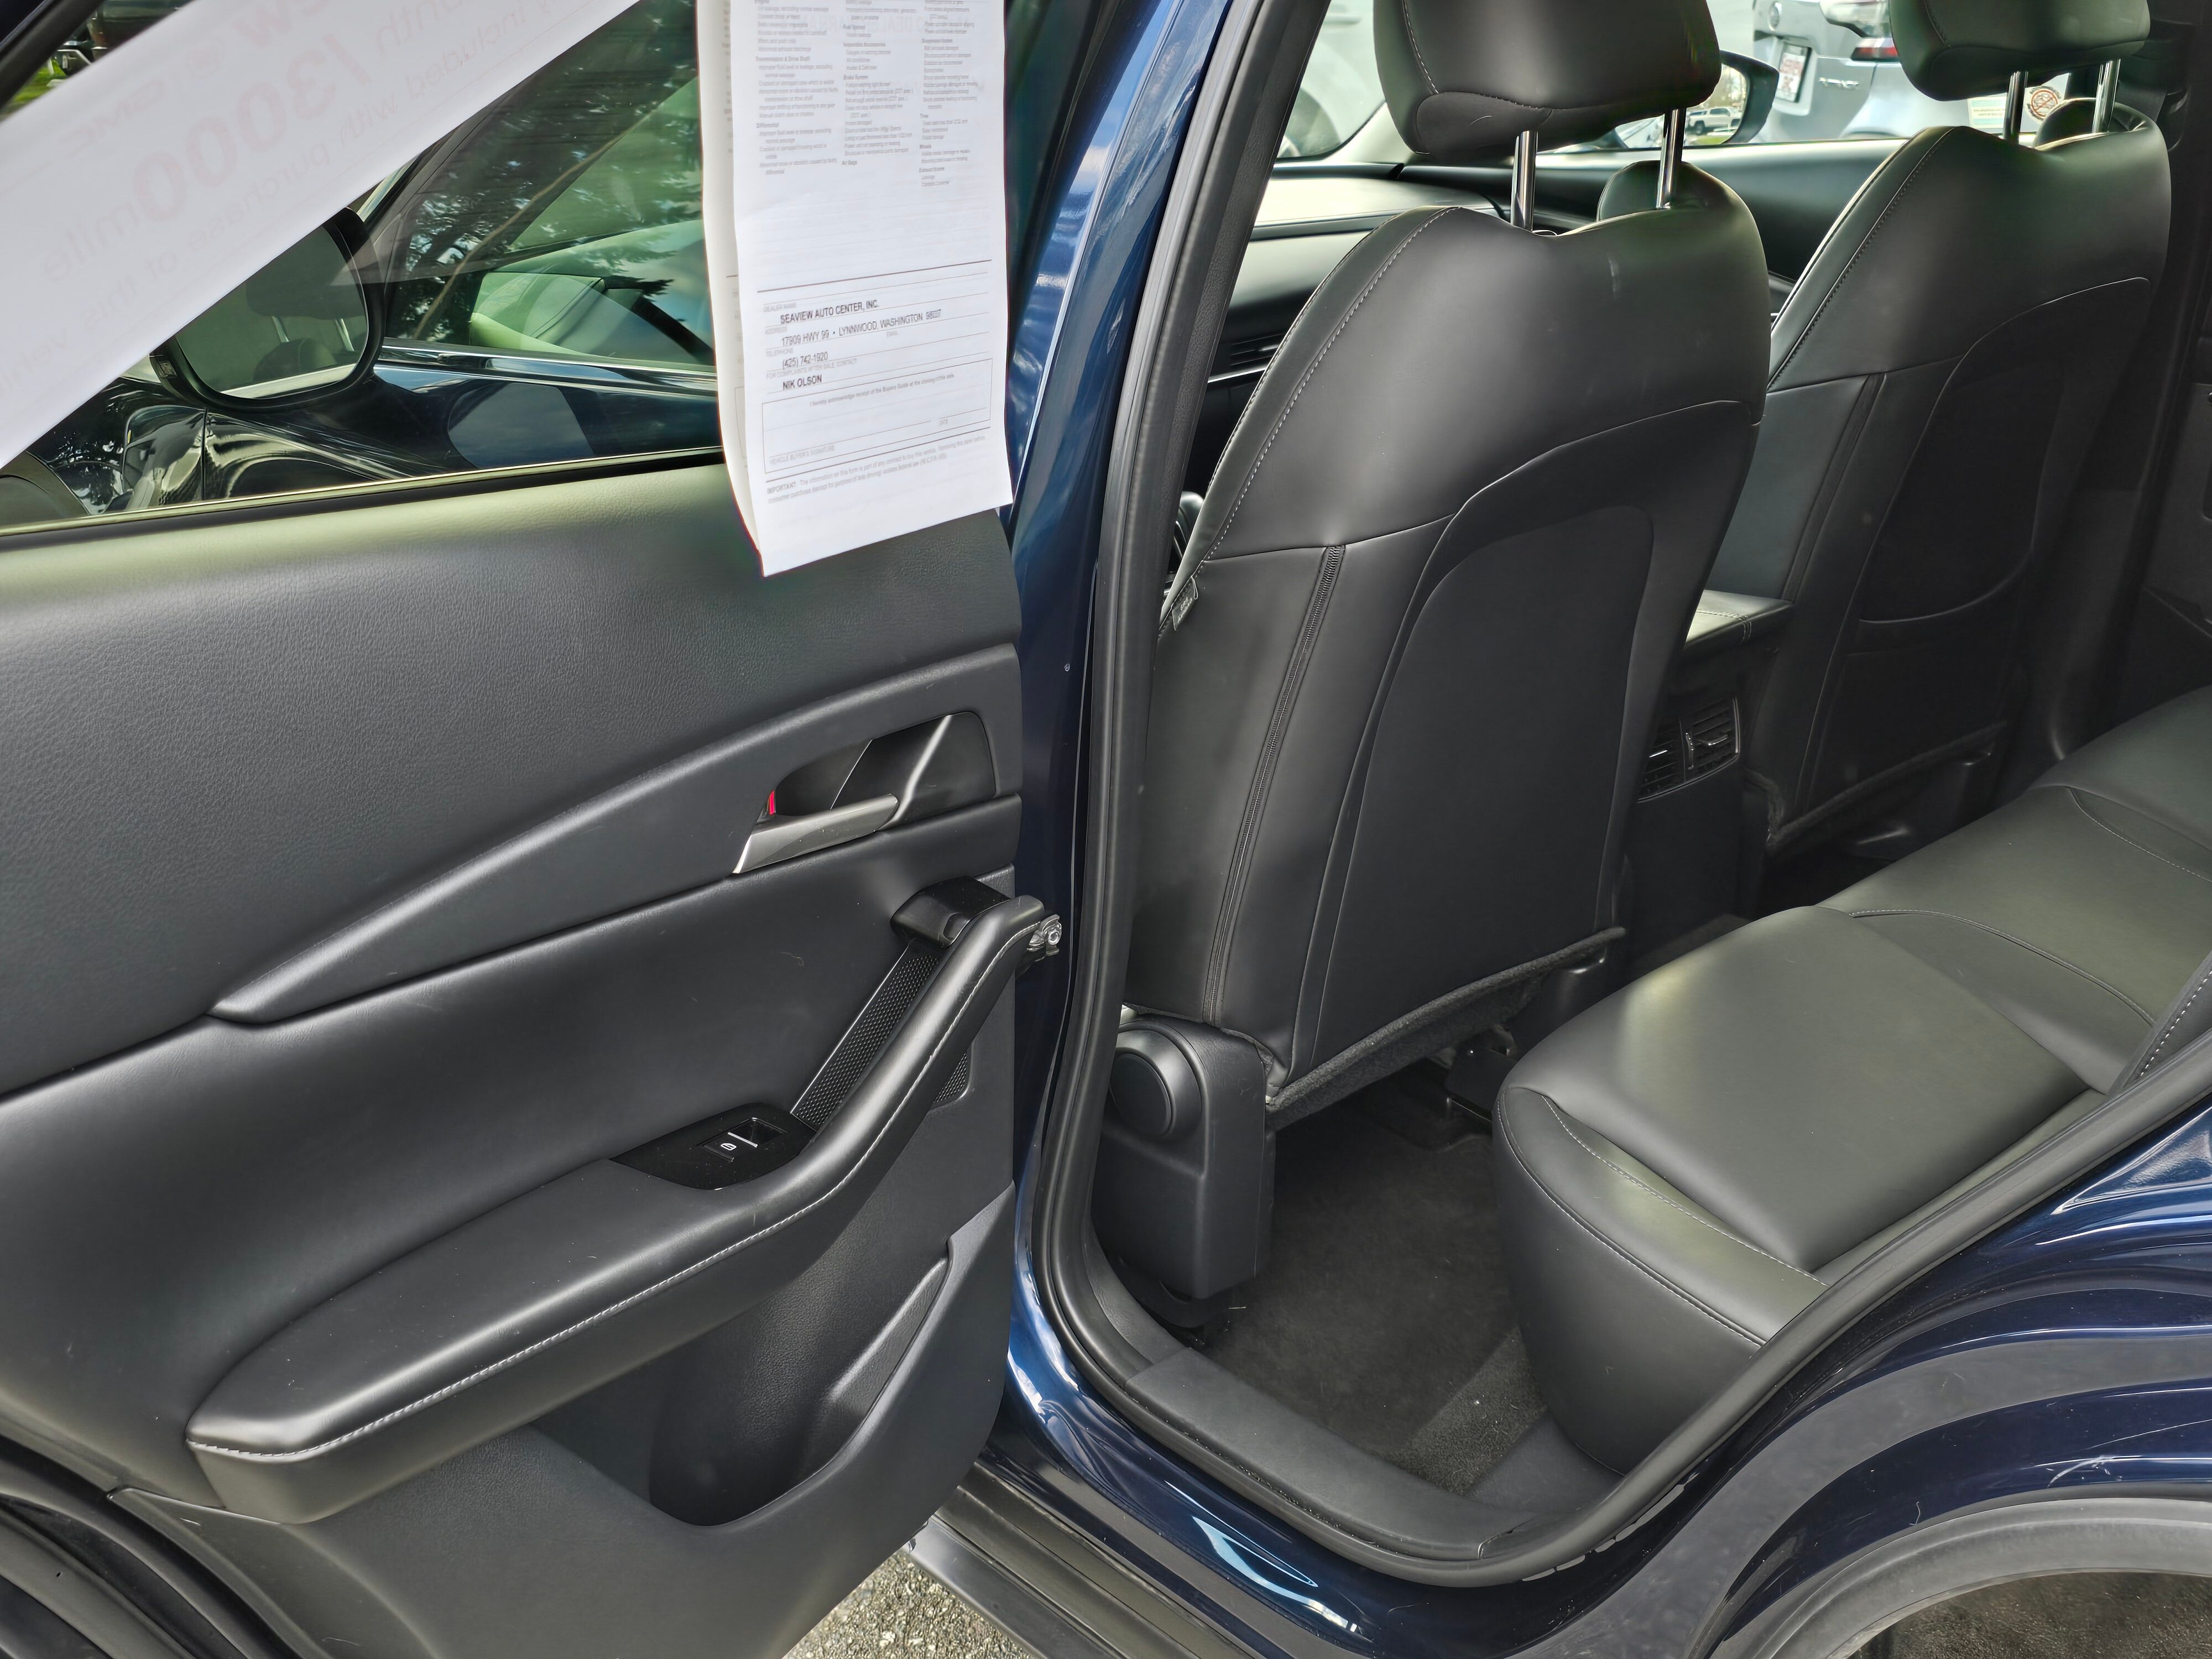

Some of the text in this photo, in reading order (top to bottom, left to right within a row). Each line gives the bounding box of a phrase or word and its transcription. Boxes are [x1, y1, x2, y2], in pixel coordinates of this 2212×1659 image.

[780, 310, 813, 324] SEAVIEW
[815, 306, 834, 317] AUTO
[803, 331, 820, 342] HWY
[880, 312, 923, 328] WASHINGTON
[782, 351, 828, 370] (425) 742-1920
[783, 374, 822, 390] NIK OLSON
